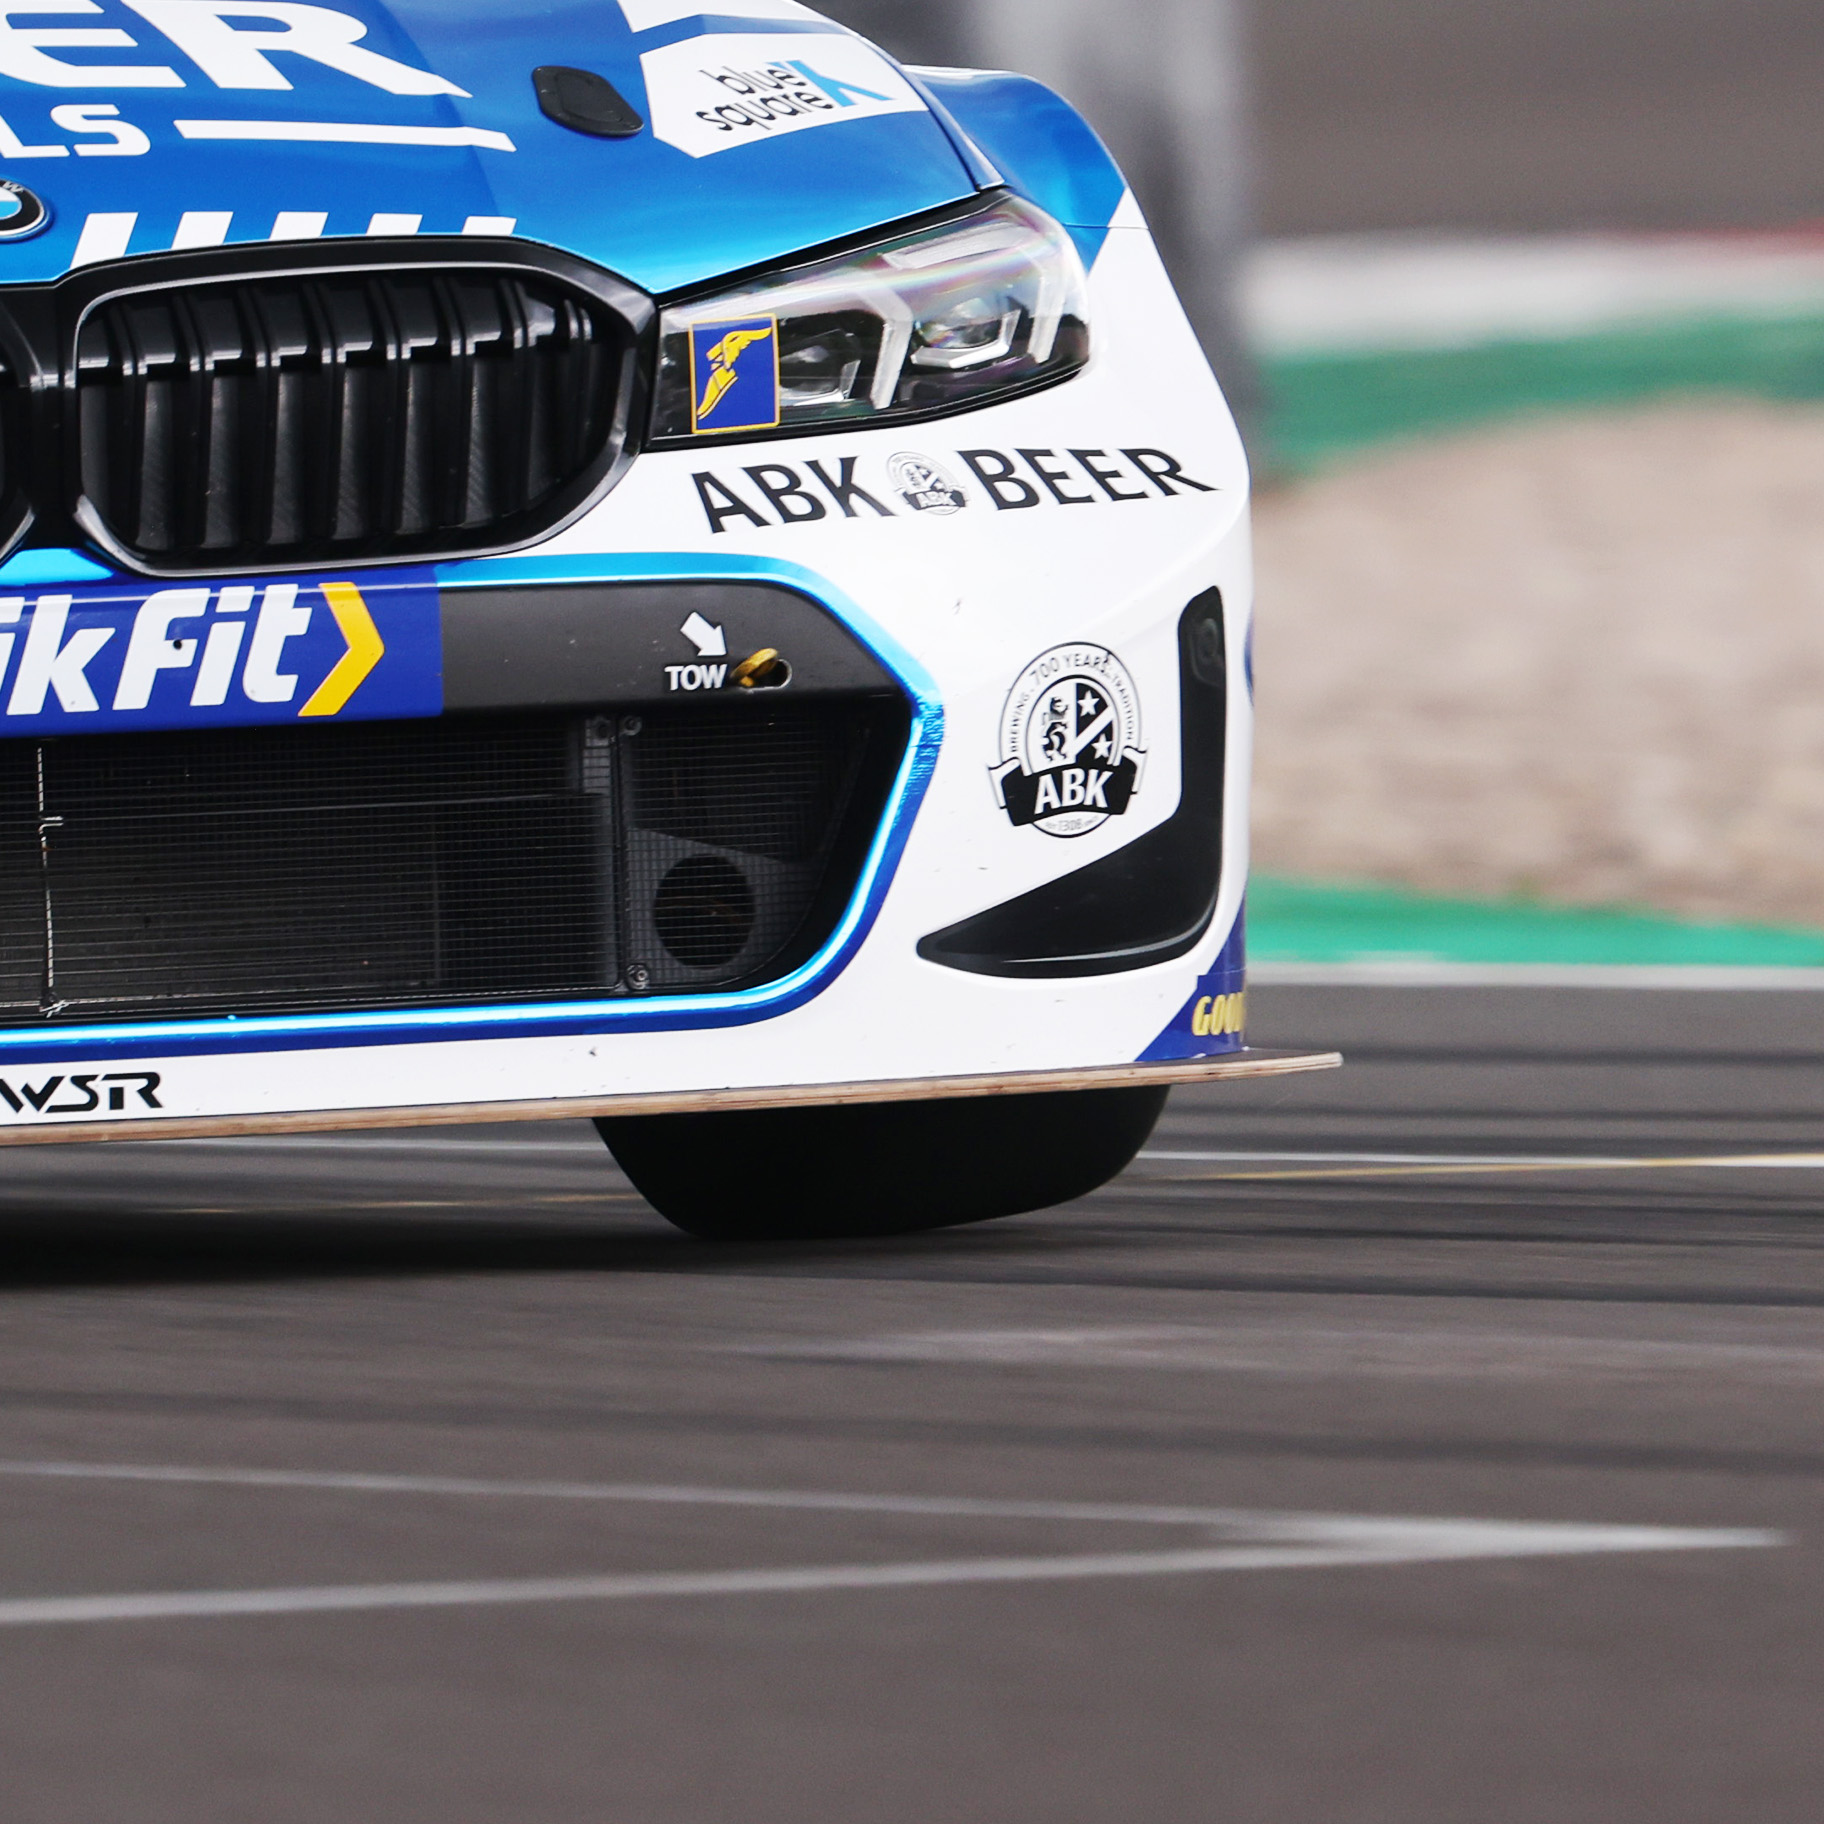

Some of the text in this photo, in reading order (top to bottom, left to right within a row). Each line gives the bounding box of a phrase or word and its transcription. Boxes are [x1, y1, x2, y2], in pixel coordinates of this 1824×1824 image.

[698, 64, 807, 95] blue
[695, 90, 834, 131] square
[690, 456, 897, 535] ABK
[955, 447, 1222, 511] BEER
[664, 664, 727, 691] TOW
[1034, 767, 1114, 815] ABK
